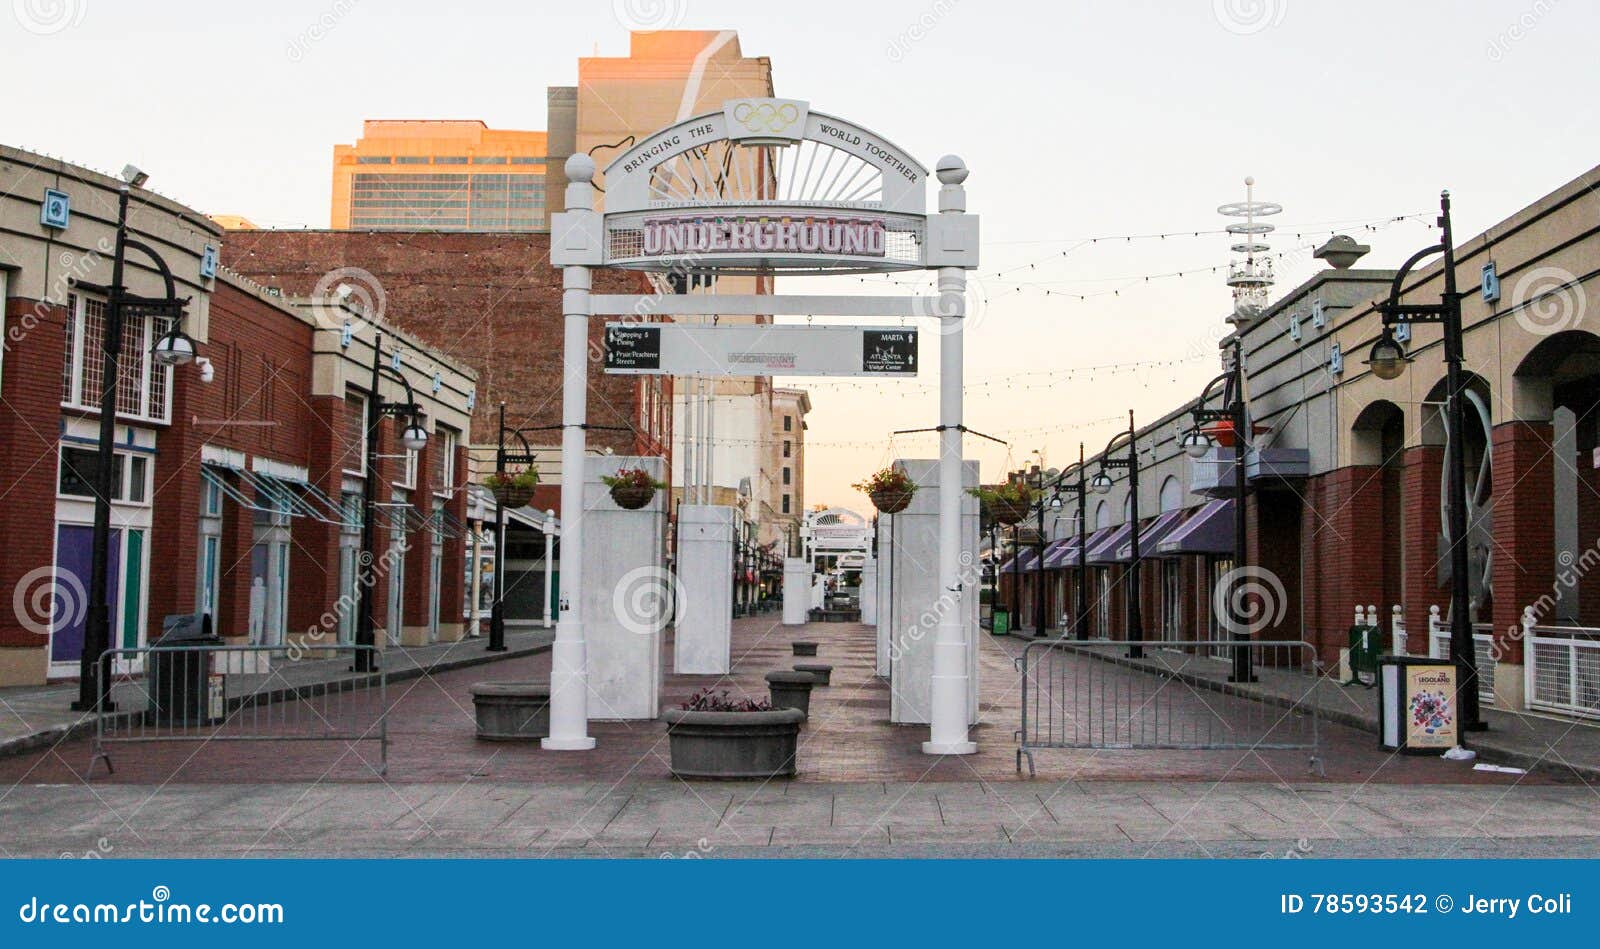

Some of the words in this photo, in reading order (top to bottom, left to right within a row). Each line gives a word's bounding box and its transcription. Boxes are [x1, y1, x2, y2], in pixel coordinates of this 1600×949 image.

[624, 135, 681, 173] BRINGING
[688, 123, 714, 138] THE
[820, 123, 861, 146] WORLD
[864, 142, 918, 185] TOGETHER
[643, 217, 886, 255] UNDERGROUND
